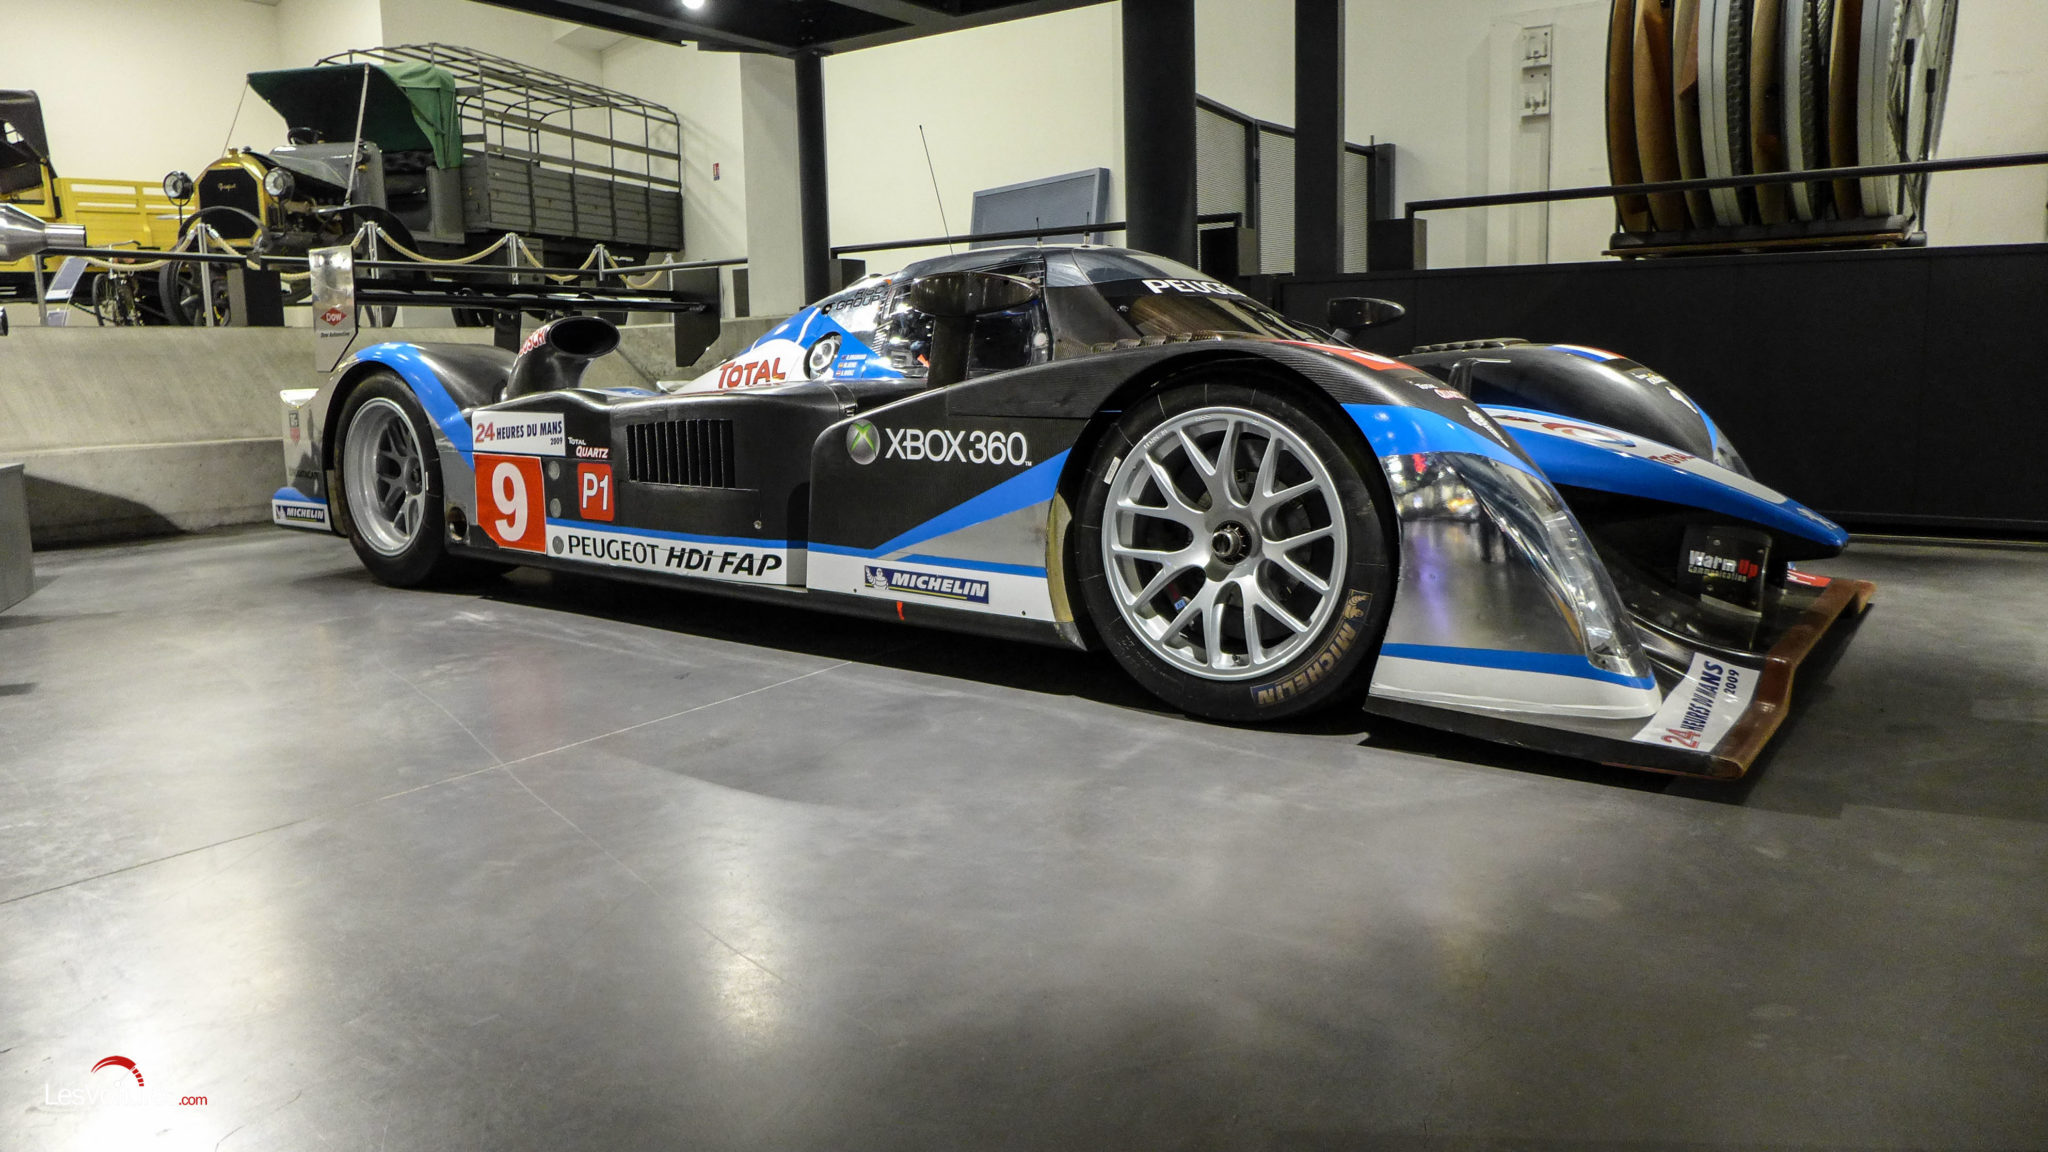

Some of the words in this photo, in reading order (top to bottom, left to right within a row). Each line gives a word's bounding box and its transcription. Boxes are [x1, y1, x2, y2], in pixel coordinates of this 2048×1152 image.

[836, 295, 881, 310] GROUP
[718, 357, 786, 389] TOTAL
[475, 422, 495, 443] 24
[496, 425, 525, 440] HEURES
[526, 423, 538, 437] DU
[539, 421, 563, 435] MANS
[550, 437, 563, 446] 2009
[575, 446, 609, 459] QUARTZ
[491, 461, 528, 542] 9
[582, 472, 609, 511] P1
[286, 507, 324, 520] MICHELIN
[568, 534, 659, 565] PEUGEOT
[665, 546, 713, 572] HDi
[718, 551, 783, 577] FAP
[891, 572, 987, 597] MICHELIN
[1258, 621, 1357, 705] MICHELIN
[1695, 660, 1724, 699] MANS
[1723, 669, 1740, 695] 2009
[1691, 692, 1714, 708] DU
[1680, 702, 1711, 732] HEURES
[1661, 728, 1701, 748] 24
